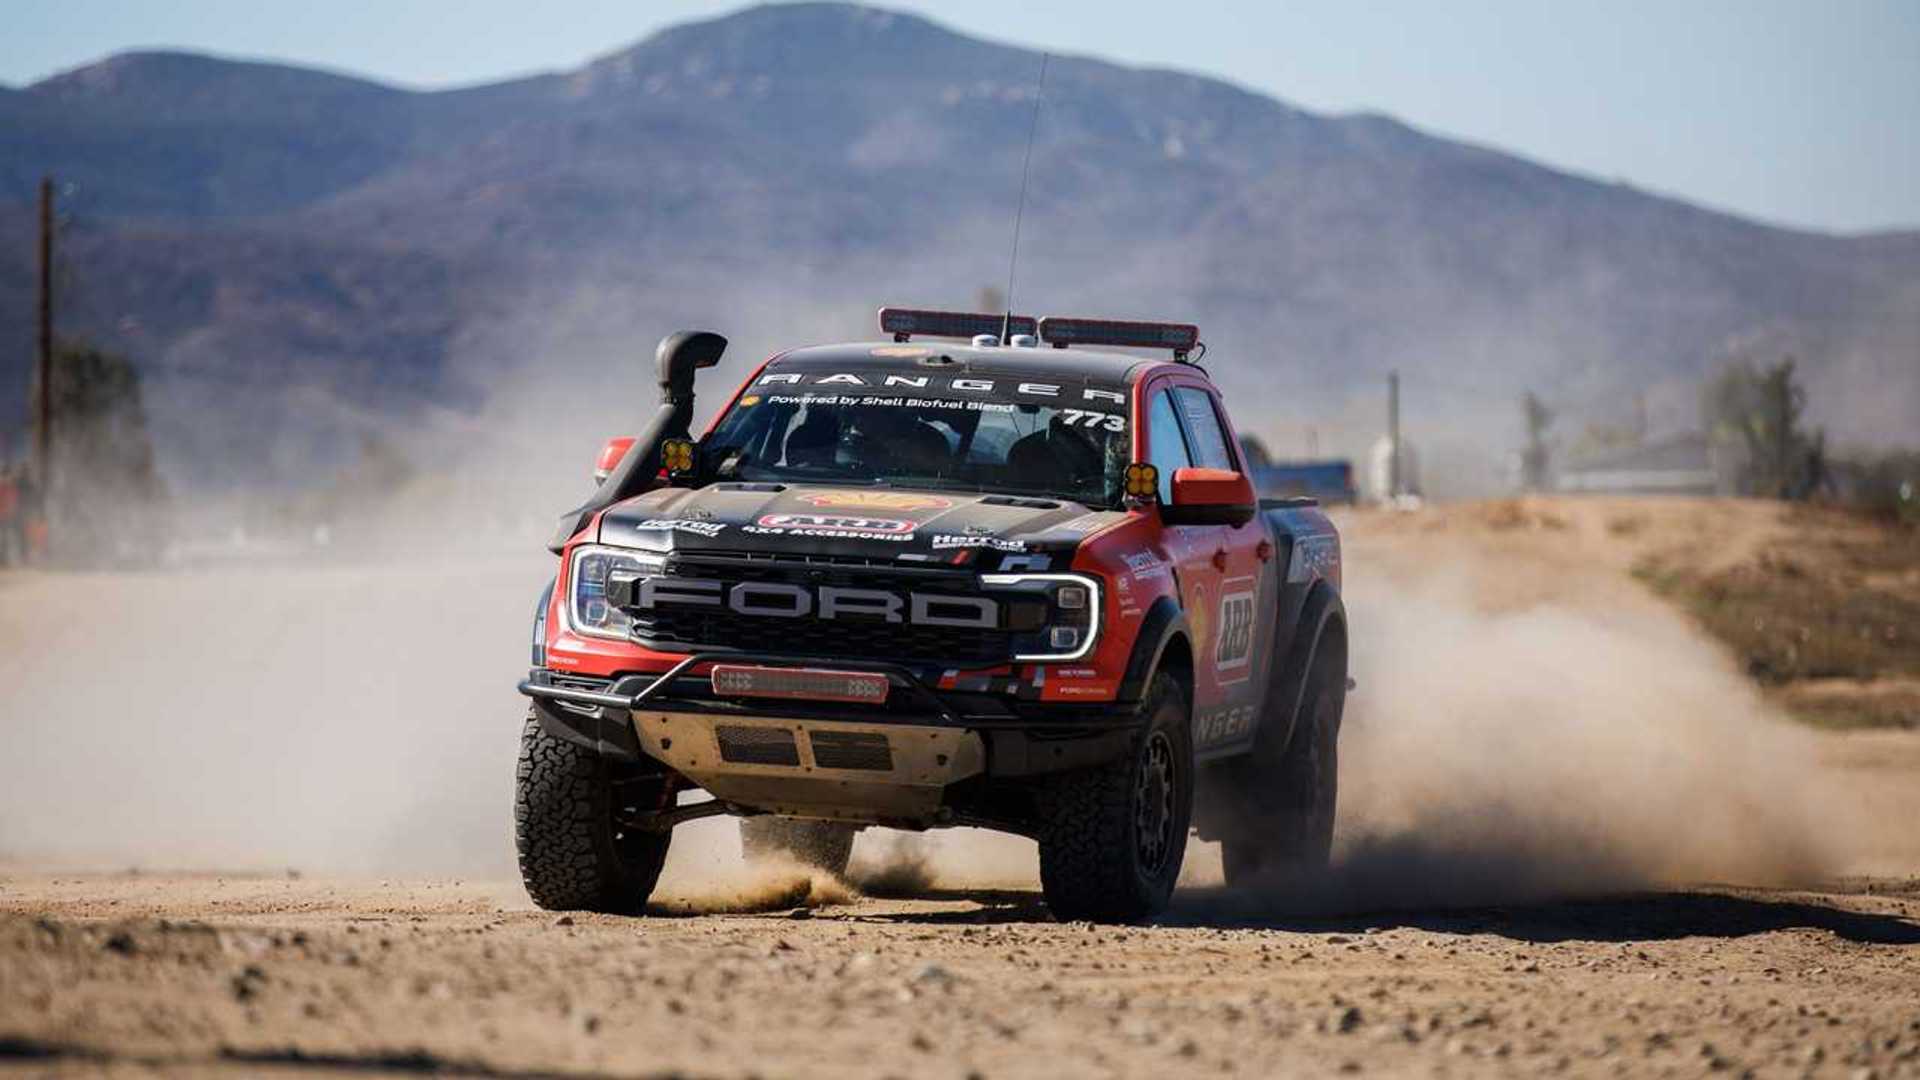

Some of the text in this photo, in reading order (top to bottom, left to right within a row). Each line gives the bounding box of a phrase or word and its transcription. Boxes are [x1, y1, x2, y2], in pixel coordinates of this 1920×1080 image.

[758, 373, 1125, 405] RANGER
[768, 394, 1015, 413] Powered by Shell Biofuel Blend
[1062, 408, 1125, 432] 773
[788, 528, 914, 542] ACCESSORIES
[639, 578, 1000, 629] FORD
[1197, 705, 1256, 742] NGER
